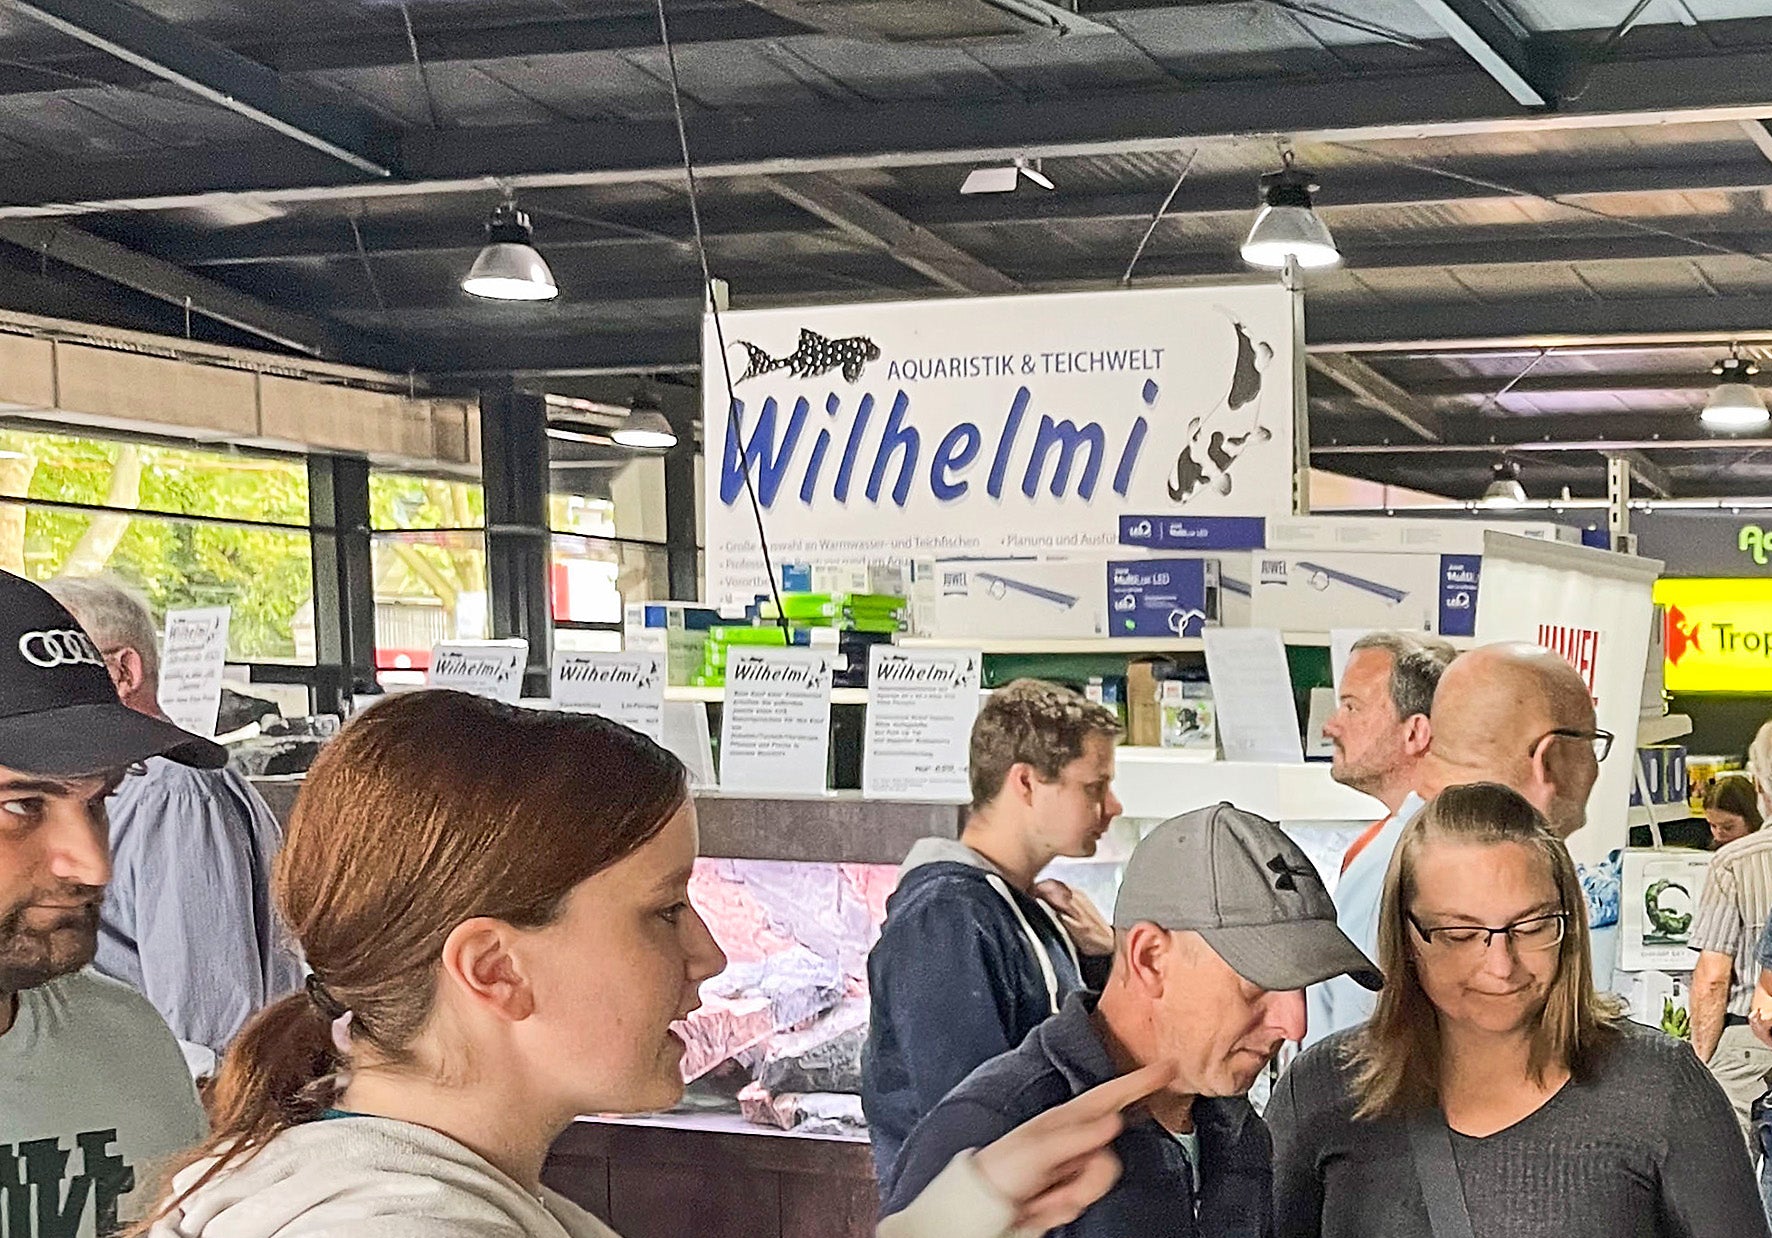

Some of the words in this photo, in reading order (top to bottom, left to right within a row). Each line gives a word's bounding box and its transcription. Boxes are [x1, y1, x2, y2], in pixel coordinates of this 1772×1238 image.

[887, 354, 1015, 381] AQUARISTIK
[1021, 355, 1036, 374] &
[1041, 347, 1166, 373] TEICHWELT
[719, 378, 1160, 509] Wilhelmi
[760, 540, 803, 551] uswahl
[1007, 533, 1054, 548] Planung
[1055, 534, 1078, 546] und
[435, 658, 502, 677] Wilhelmi
[559, 664, 641, 683] Wilhelmi
[734, 663, 812, 682] Wilhelmi
[877, 663, 957, 682] Wilhelmi
